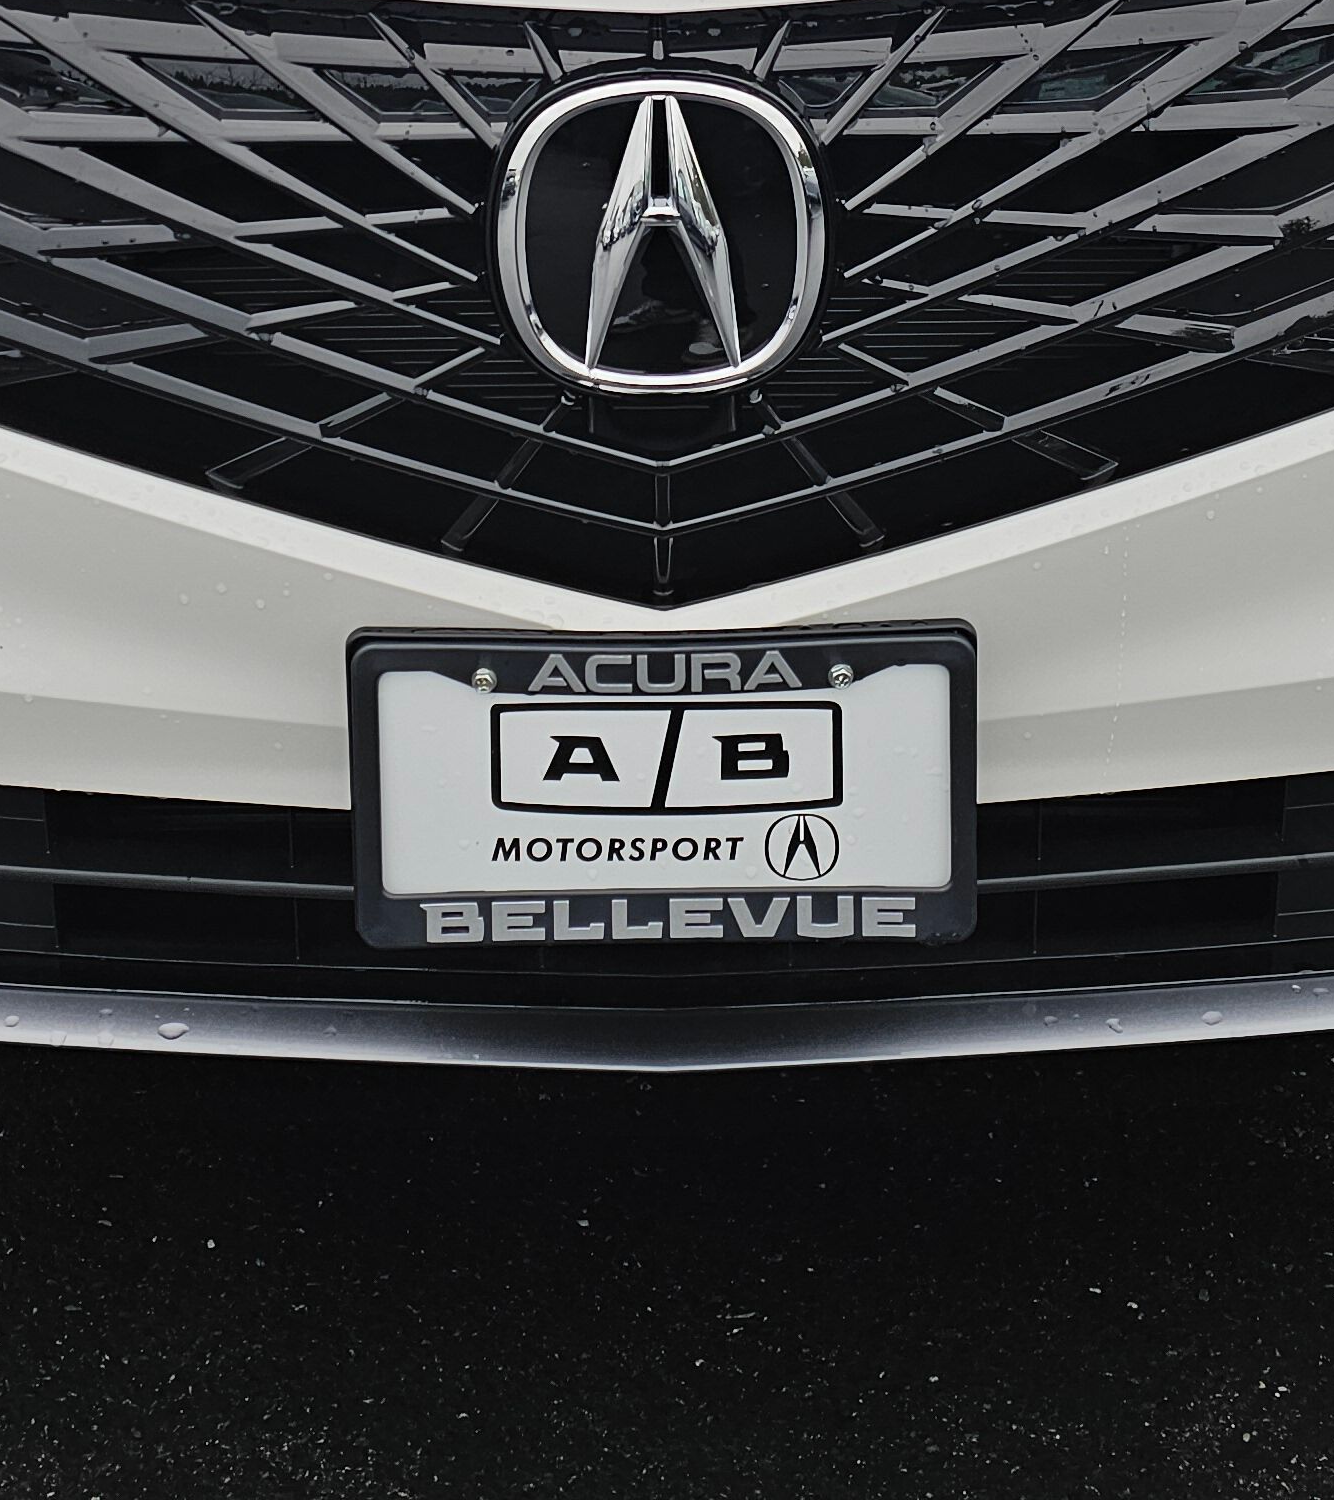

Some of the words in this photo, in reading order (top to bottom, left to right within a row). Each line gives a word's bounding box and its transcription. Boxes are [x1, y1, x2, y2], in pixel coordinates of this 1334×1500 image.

[527, 651, 803, 694] ACURA
[542, 735, 620, 782] A
[711, 732, 790, 781] B
[490, 836, 744, 863] MOTORSPORT
[419, 896, 917, 944] BELLEVUE
